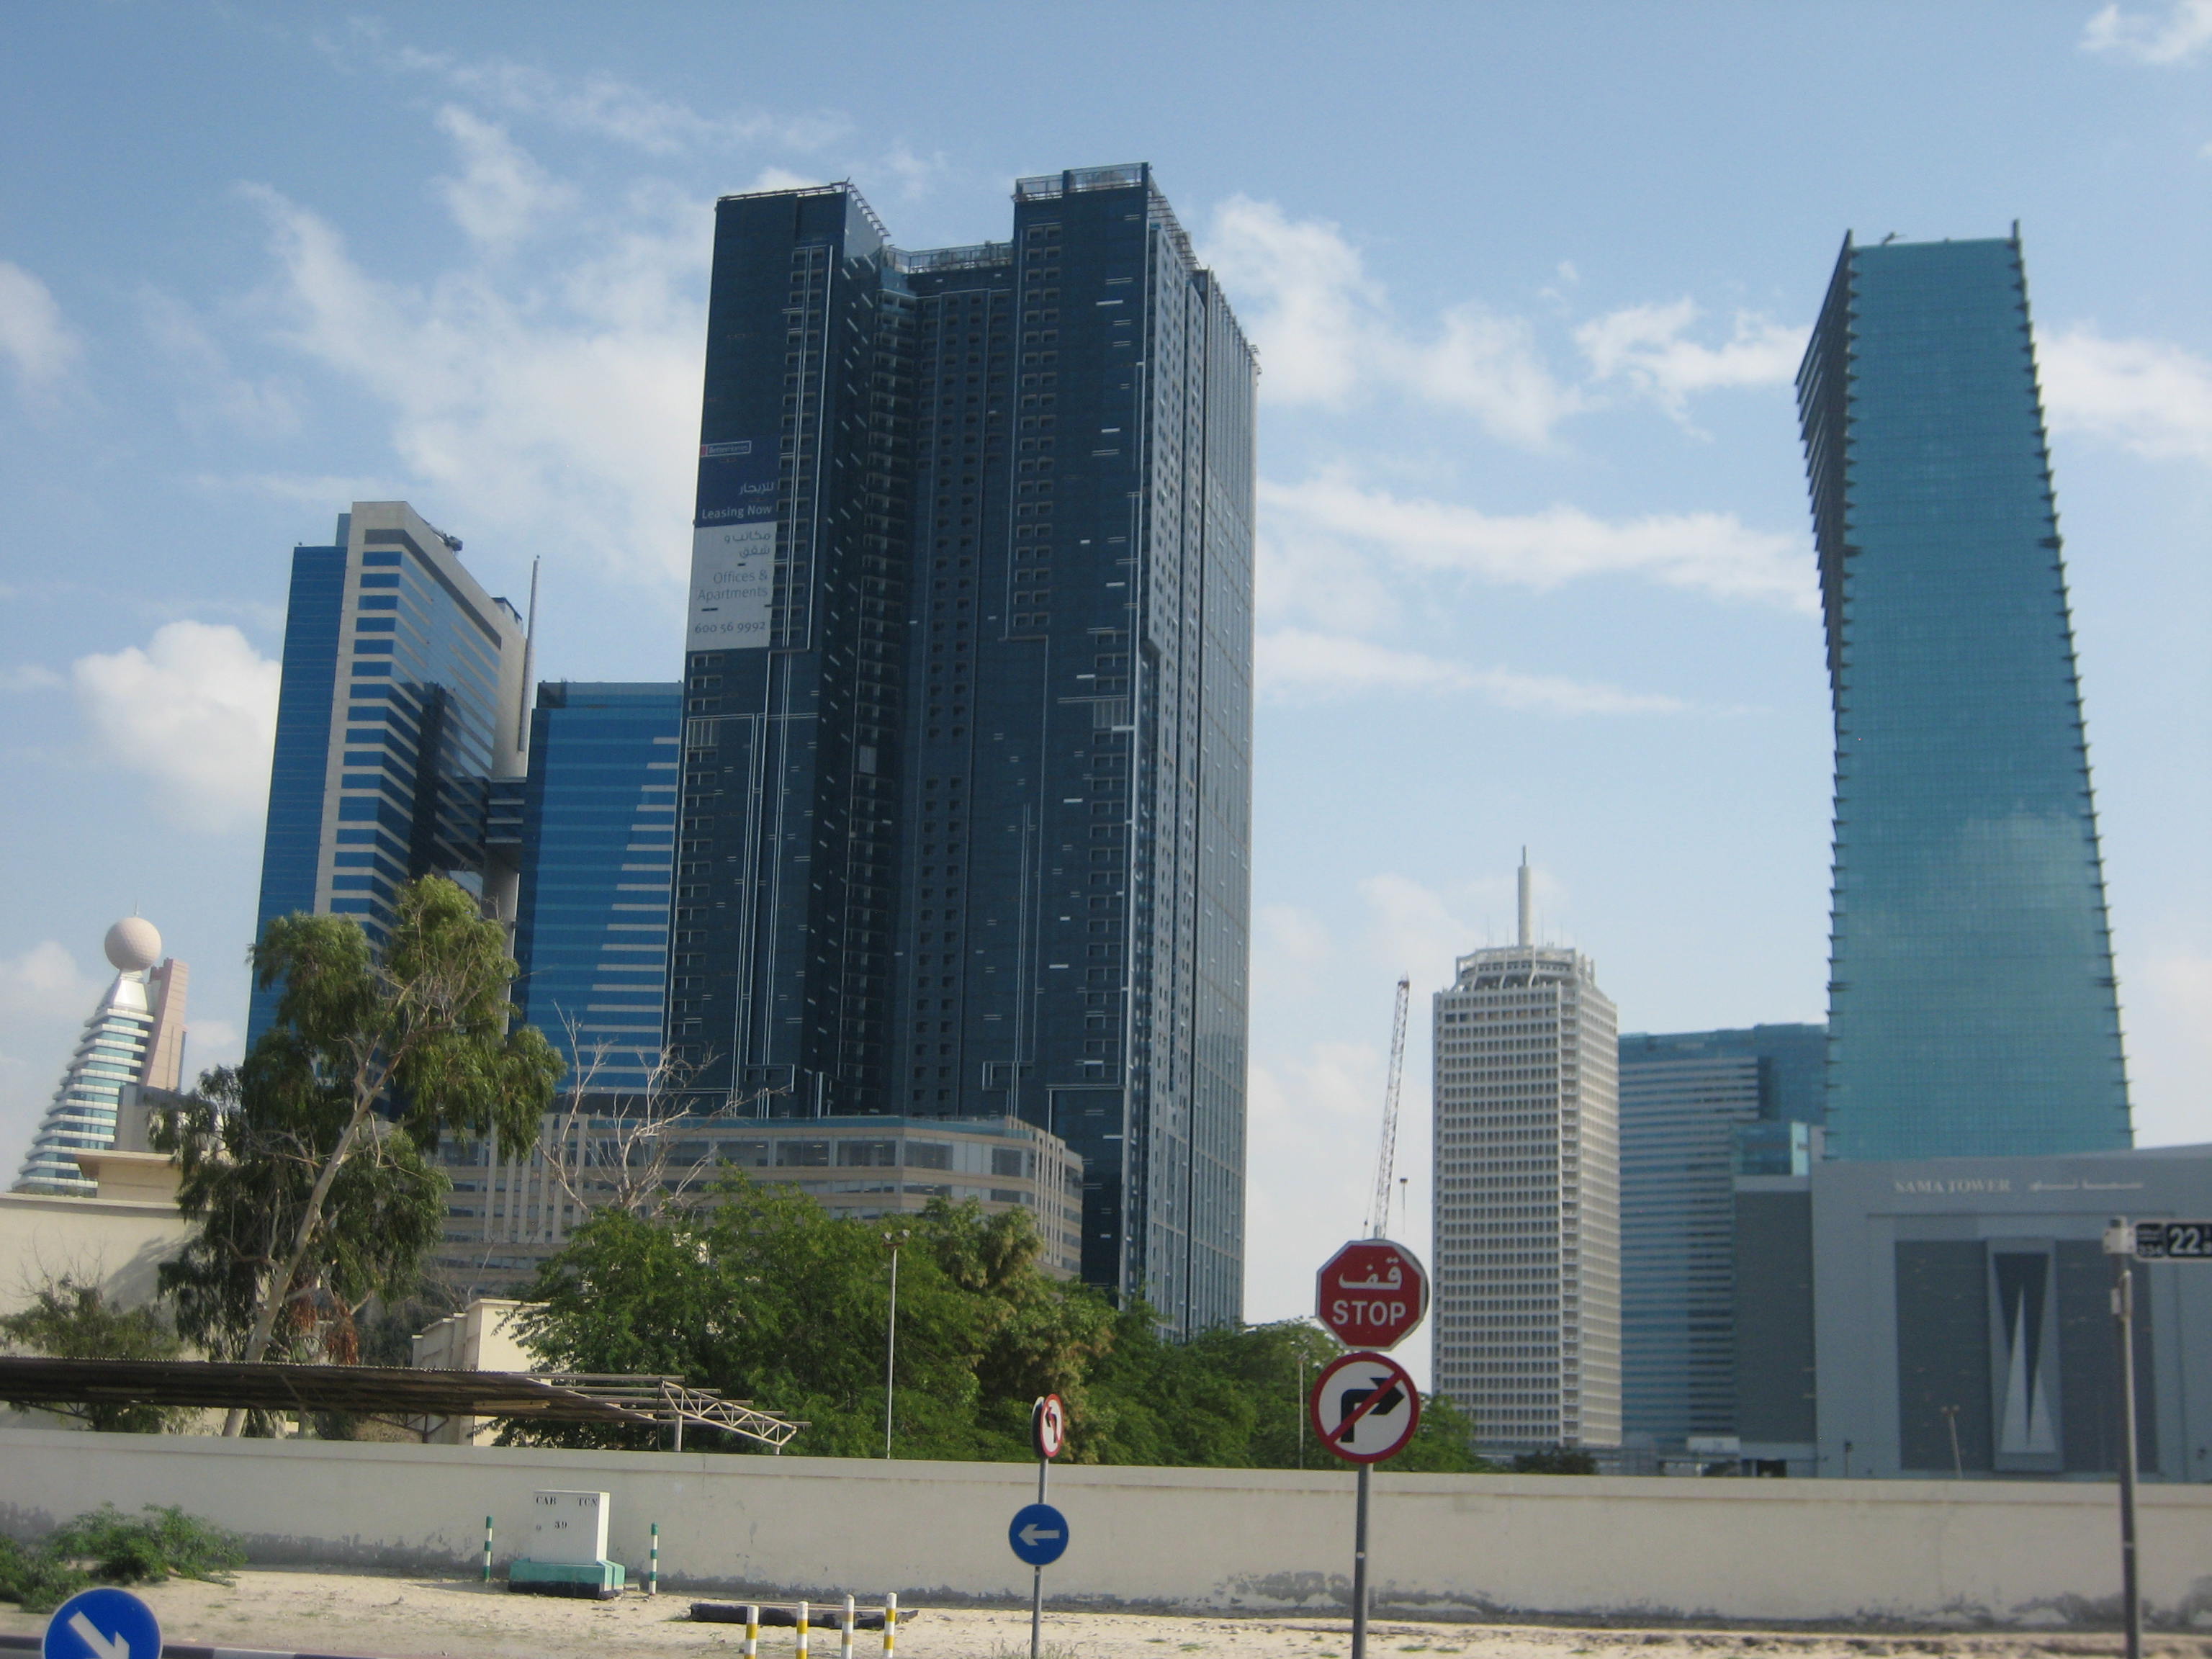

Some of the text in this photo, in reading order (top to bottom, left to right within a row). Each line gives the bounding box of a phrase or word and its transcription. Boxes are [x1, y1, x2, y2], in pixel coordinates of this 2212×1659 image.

[702, 504, 772, 519] Leasing Now
[714, 570, 768, 585] Offices &
[697, 588, 768, 602] Apartments
[695, 621, 766, 634] 600 56 9992
[1894, 1179, 2012, 1192] SAMA TOWER
[2169, 1226, 2200, 1254] 22
[1339, 1256, 1403, 1290] قف
[1333, 1300, 1406, 1326] STOP
[536, 1496, 557, 1505] CAB
